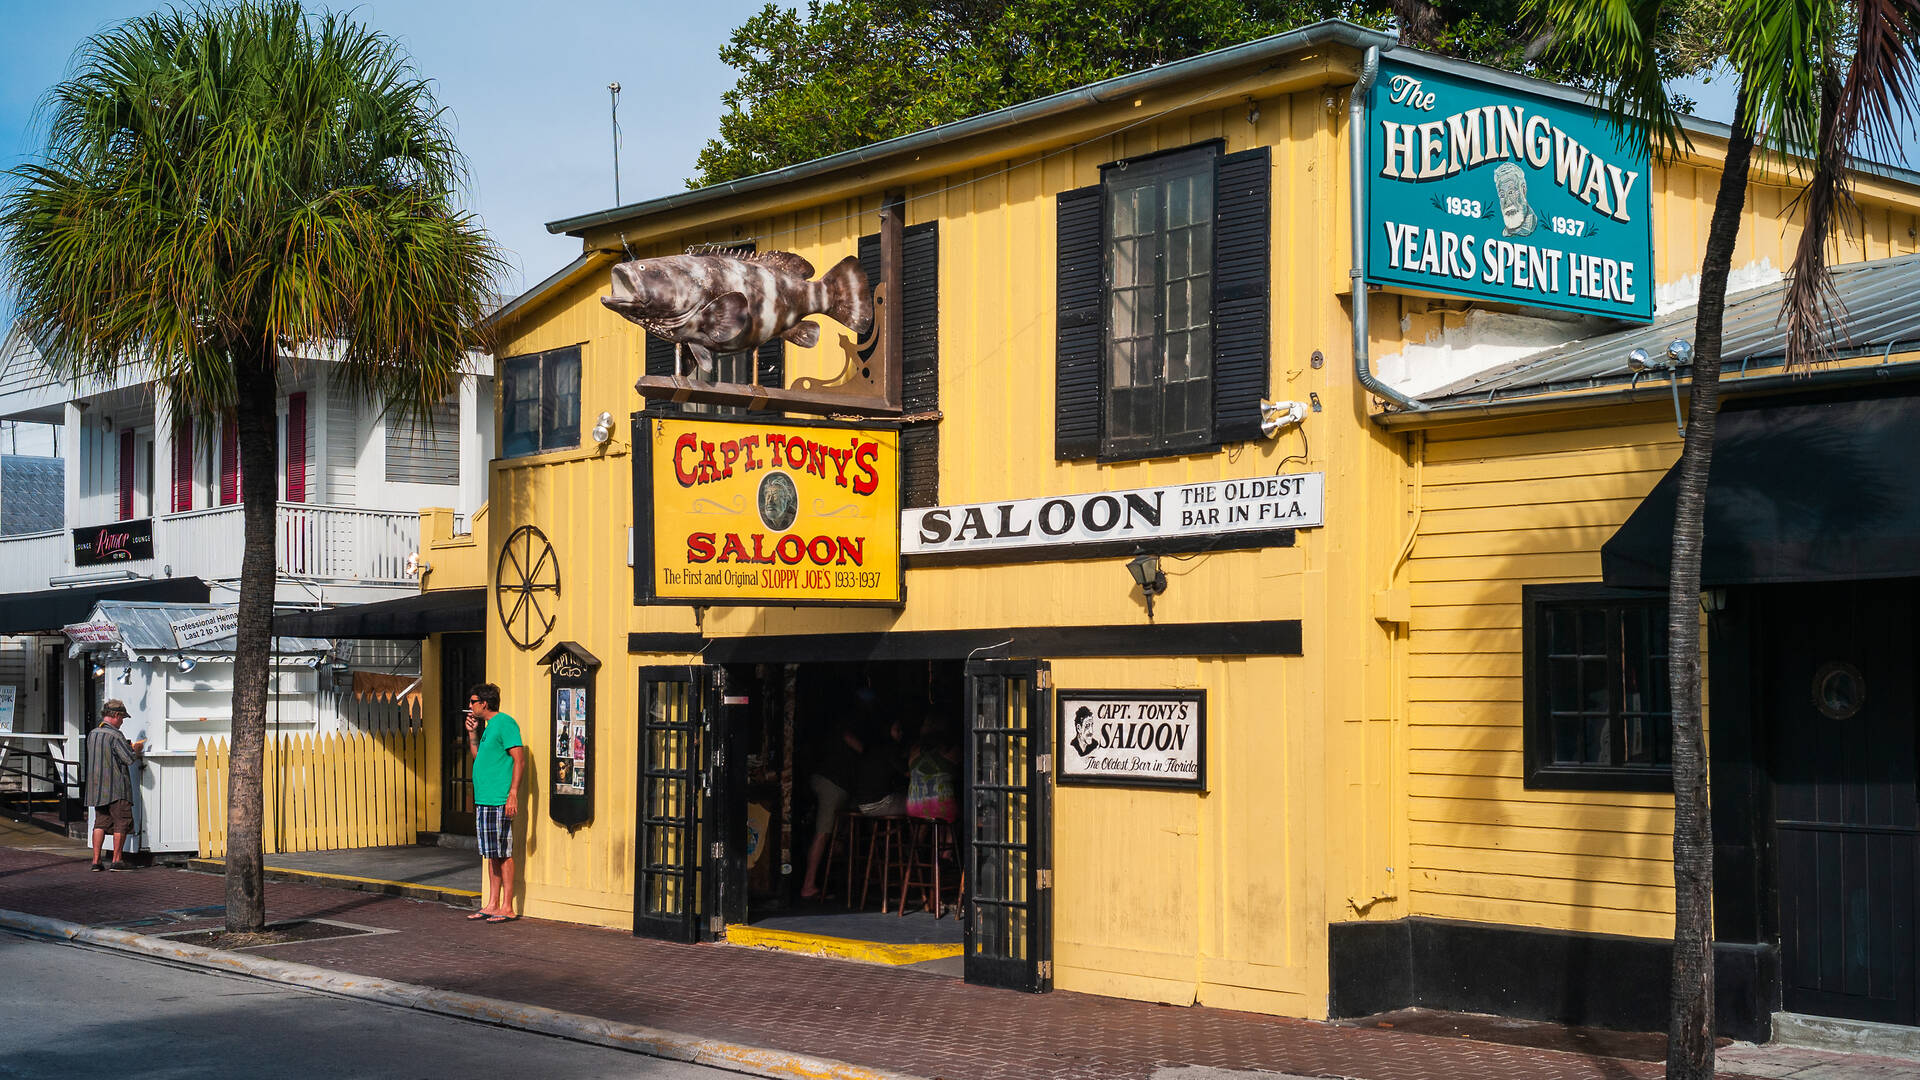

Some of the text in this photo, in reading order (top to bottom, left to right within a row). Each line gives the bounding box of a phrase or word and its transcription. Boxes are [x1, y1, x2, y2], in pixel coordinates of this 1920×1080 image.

[1389, 75, 1436, 111] The
[1379, 105, 1639, 223] HEMINGWAY
[1446, 196, 1481, 218] 1933
[1551, 216, 1585, 237] 1937
[1384, 221, 1636, 303] YEARS SPENT HERE
[673, 433, 879, 496] CAPT. TONY'S
[1181, 477, 1306, 505] THE OLDEST
[919, 491, 1164, 545] SALOON
[1181, 501, 1308, 527] BAR IN FLA.
[75, 542, 92, 551] LOUNGE
[132, 535, 151, 544] LOUNGE
[687, 532, 865, 566] SALOON
[663, 568, 681, 585] The
[683, 568, 702, 585] First
[704, 570, 722, 585] and
[724, 569, 759, 588] Original
[761, 568, 799, 589] SLOPPY
[801, 568, 831, 589] JOE'S
[173, 612, 238, 633] Professional Henna
[184, 631, 200, 640] Last
[214, 625, 219, 633] 3
[1097, 702, 1189, 720] CAPT. TONY'S
[1099, 722, 1190, 751] SALOON
[1085, 756, 1198, 773] The Oldest Bar in Florida
